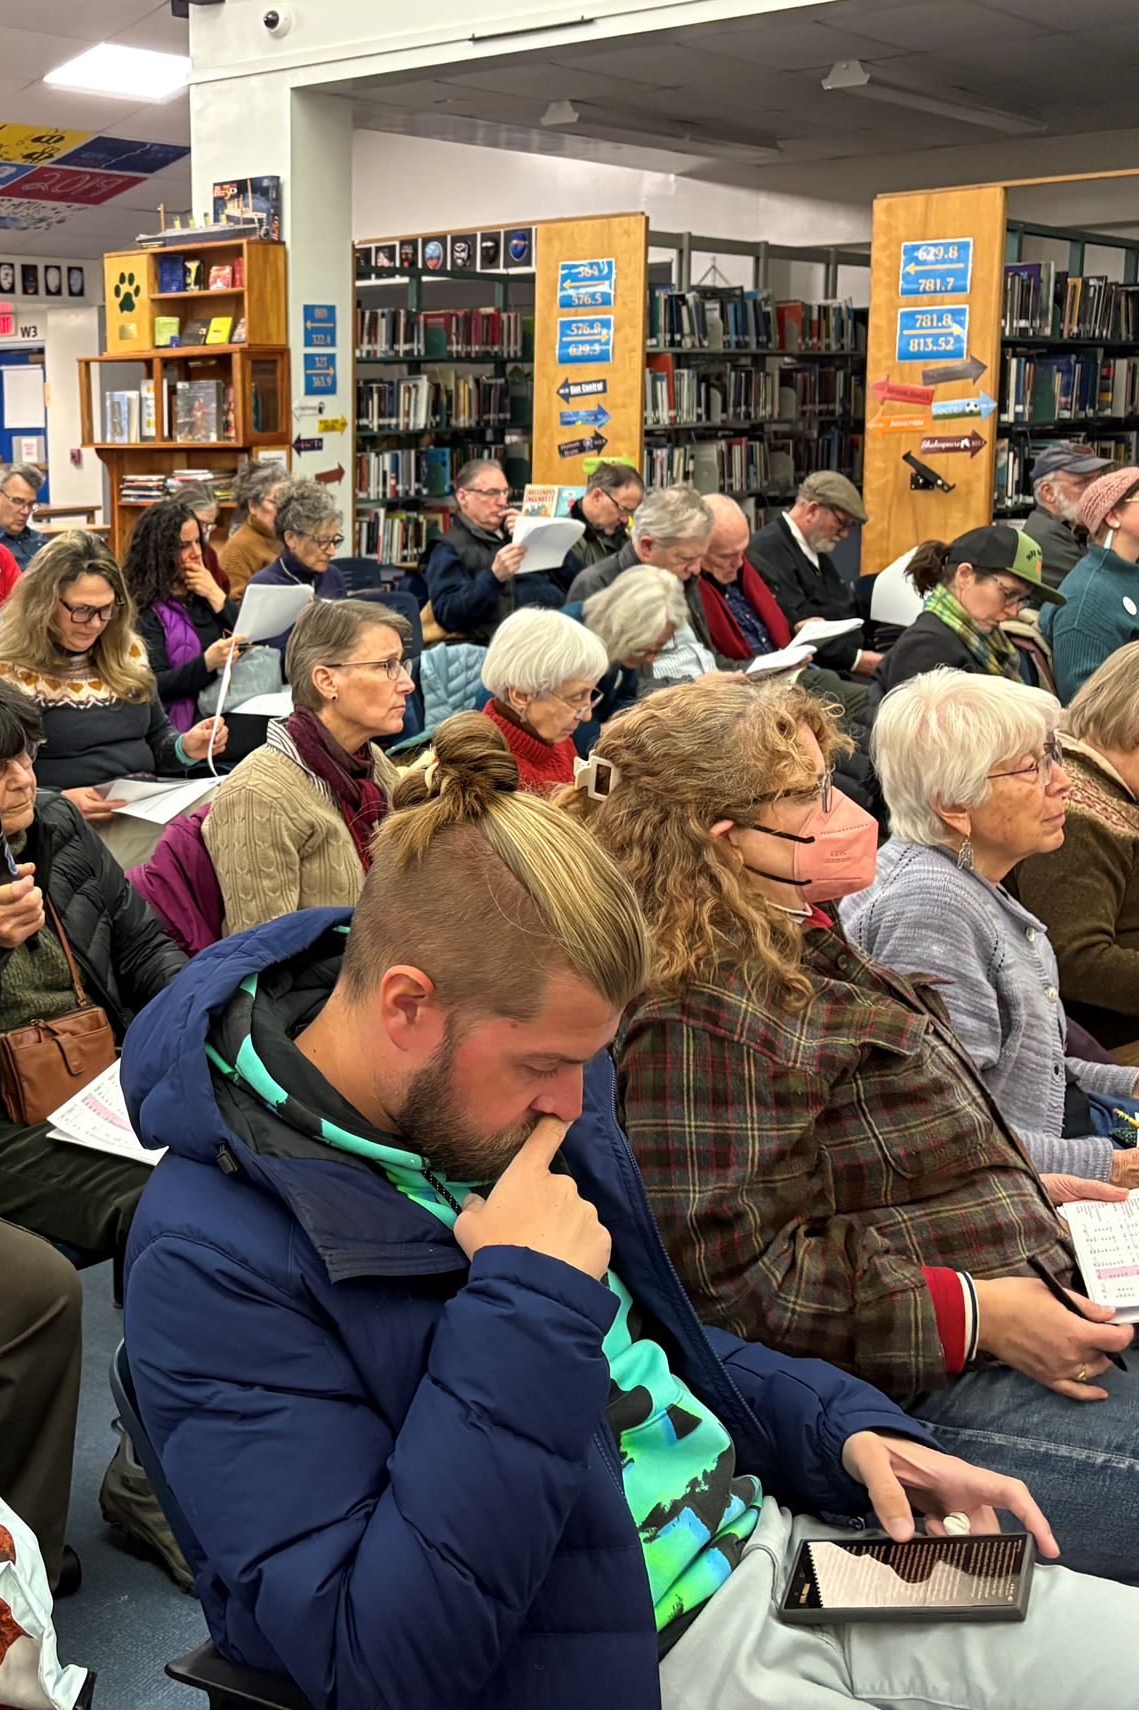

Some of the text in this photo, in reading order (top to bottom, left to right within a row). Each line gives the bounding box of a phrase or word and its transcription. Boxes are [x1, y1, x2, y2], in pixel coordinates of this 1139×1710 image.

[21, 171, 129, 197] 2019
[917, 245, 959, 261] 629.8
[918, 277, 955, 292] 781.7
[572, 292, 602, 306] 576.5
[915, 313, 953, 328] 781.8
[20, 325, 38, 338] W3
[571, 322, 602, 335] 576.8
[909, 337, 955, 352] 813.52
[582, 381, 603, 393] Control
